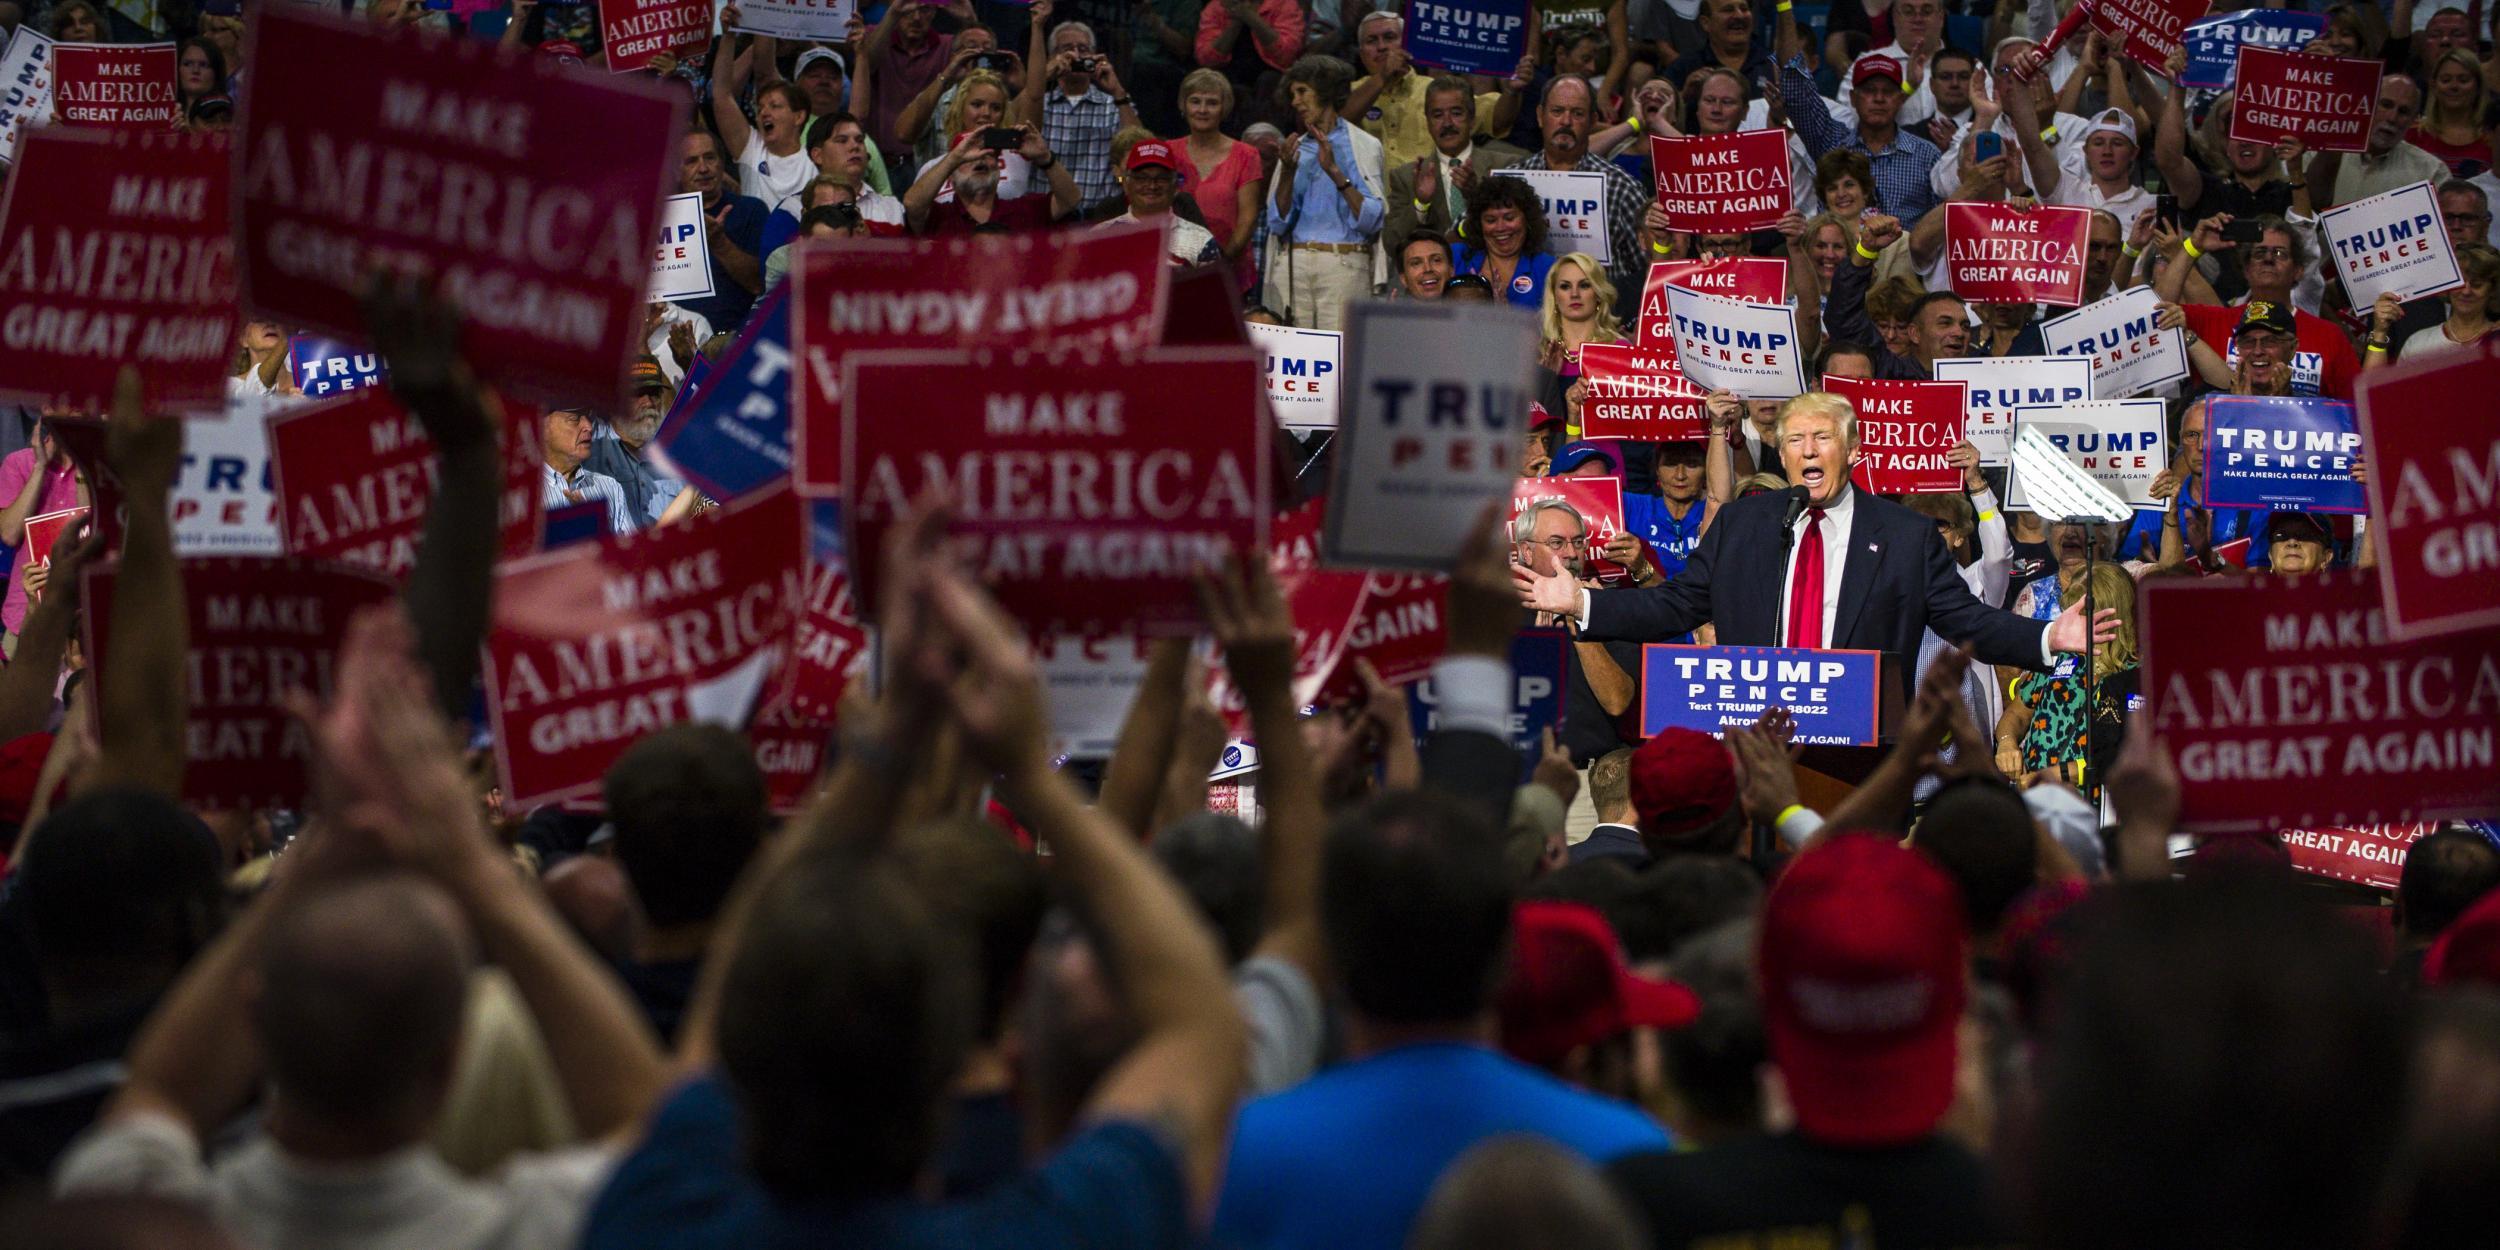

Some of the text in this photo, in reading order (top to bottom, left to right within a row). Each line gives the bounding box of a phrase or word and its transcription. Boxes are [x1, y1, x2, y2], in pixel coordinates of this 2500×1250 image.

[607, 4, 711, 42] AMERICA
[1415, 1, 1521, 31] TRUMP
[2101, 3, 2139, 33] GREAT
[616, 27, 706, 57] GREAT AGAIN
[1421, 22, 1508, 44] PENCE
[2197, 24, 2316, 43] TRUMP
[98, 64, 142, 76] MAKE
[2285, 68, 2334, 86] MAKE
[58, 81, 176, 102] AMERICA
[2238, 81, 2372, 116] AMERICA
[66, 107, 169, 122] GREAT AGAIN
[2246, 110, 2360, 134] GREAT AGAIN
[1692, 150, 1739, 166] MAKE
[1659, 166, 1787, 194] AMERICA
[249, 125, 646, 285] AMERICA
[1666, 195, 1779, 214] GREAT AGAIN
[1991, 218, 2039, 233] MAKE
[2336, 213, 2432, 258] TRUMP
[1951, 238, 2081, 266] AMERICA
[2349, 239, 2428, 272] PENCE
[1960, 266, 2069, 285] GREAT AGAIN
[2390, 262, 2411, 272] GREAT
[1690, 274, 1736, 287] MAKE
[4, 305, 134, 358] GREAT
[1675, 313, 1787, 350] TRUMP
[1686, 339, 1776, 365] PENCE
[2093, 334, 2160, 369] ENCE
[303, 354, 388, 379] TRU
[1632, 358, 1681, 370] MAKE
[1700, 360, 1727, 371] AMERICA
[1729, 366, 1752, 374] GREAT
[2121, 358, 2141, 369] GREAT
[317, 375, 378, 394] PEN
[1862, 397, 1913, 414] MAKE
[1971, 388, 2082, 408] RUMP
[984, 391, 1126, 437] MAKE
[1595, 405, 1709, 419] GREAT AGAI
[1856, 420, 1958, 447] ERICA
[2217, 428, 2362, 452] TRUMP
[1888, 454, 1949, 470] AGAIN
[2083, 456, 2146, 469] NCE
[2228, 453, 2347, 470] PENCE
[857, 448, 1254, 521] AMERICA
[2223, 470, 2247, 478] MAKE
[2250, 471, 2288, 479] AMERICA
[604, 549, 721, 609] MAKE
[1348, 599, 1438, 649] GAIN
[1674, 657, 1845, 684] TRUMP
[1688, 683, 1827, 702] PENCE
[1689, 702, 1712, 711] Text
[1717, 703, 1765, 712] TRUMP
[1809, 736, 1850, 744] AGAIN!
[2179, 726, 2493, 782] GREAT AGAIN
[2278, 827, 2344, 853] GREAT
